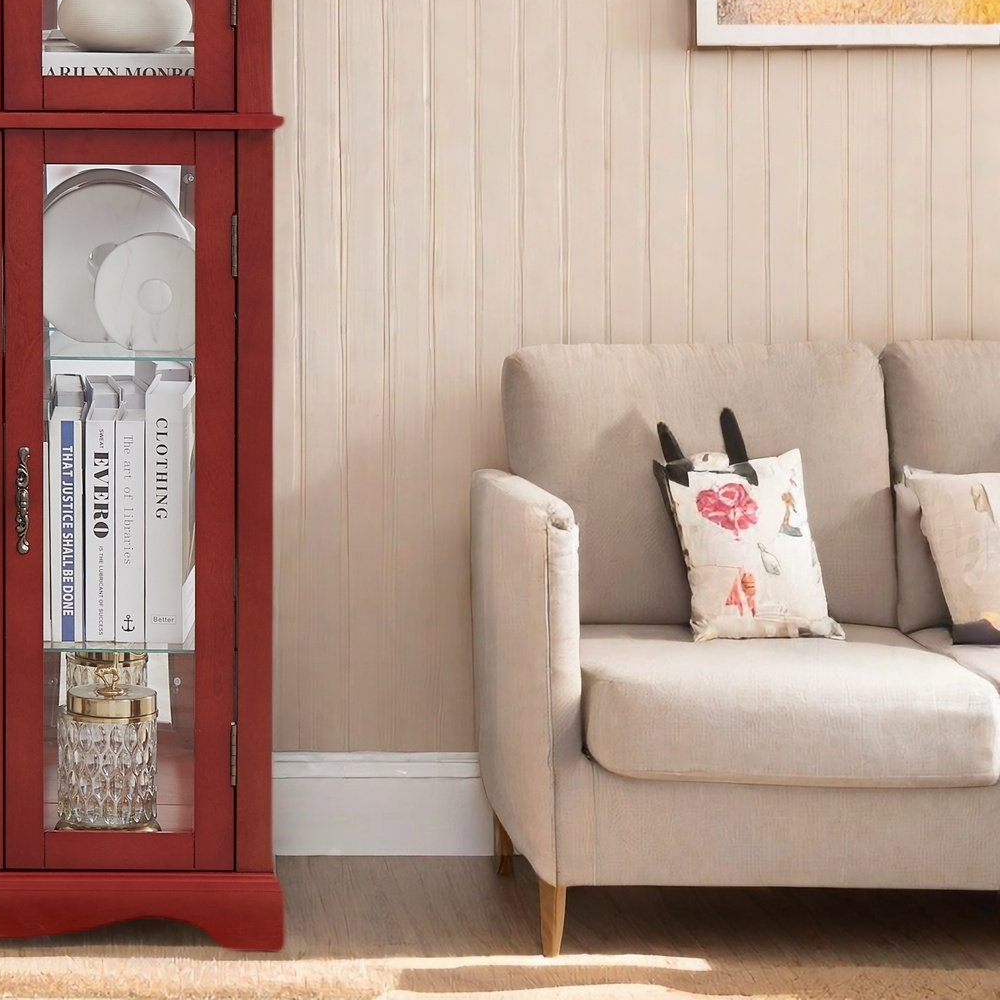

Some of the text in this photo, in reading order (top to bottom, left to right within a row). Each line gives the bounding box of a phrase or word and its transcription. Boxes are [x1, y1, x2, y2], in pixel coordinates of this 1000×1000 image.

[42, 66, 119, 76] ARILYN
[93, 451, 109, 538] EVERO
[123, 435, 134, 565] The art of libraries
[155, 417, 168, 519] CLOTHING
[62, 446, 74, 616] THAT JUSTICE SHALL BE DONE
[98, 599, 104, 607] OF
